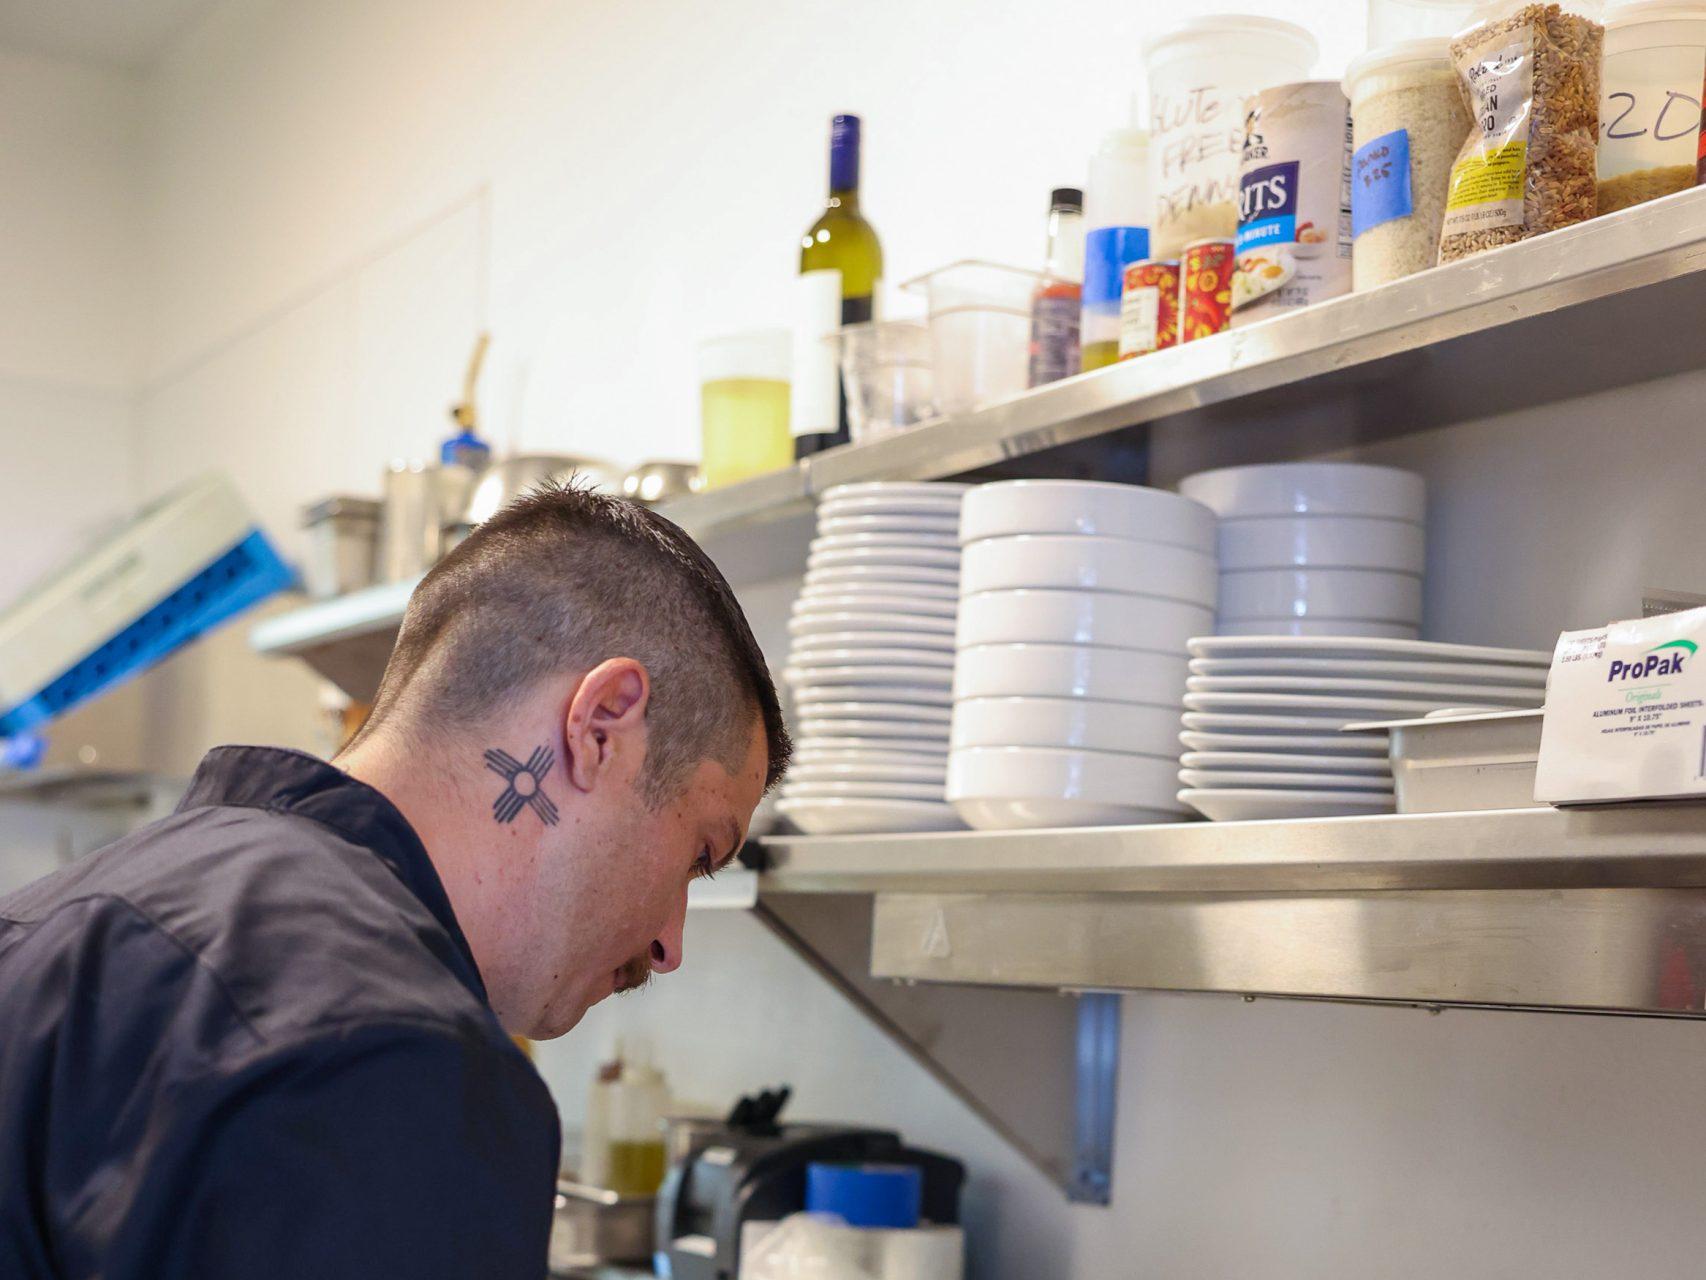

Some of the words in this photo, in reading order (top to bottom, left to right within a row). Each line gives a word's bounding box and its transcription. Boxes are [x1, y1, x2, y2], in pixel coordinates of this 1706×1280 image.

[1607, 652, 1686, 683] ProPak
[1593, 708, 1623, 718] ALUMINUM
[1624, 706, 1637, 714] FOIL
